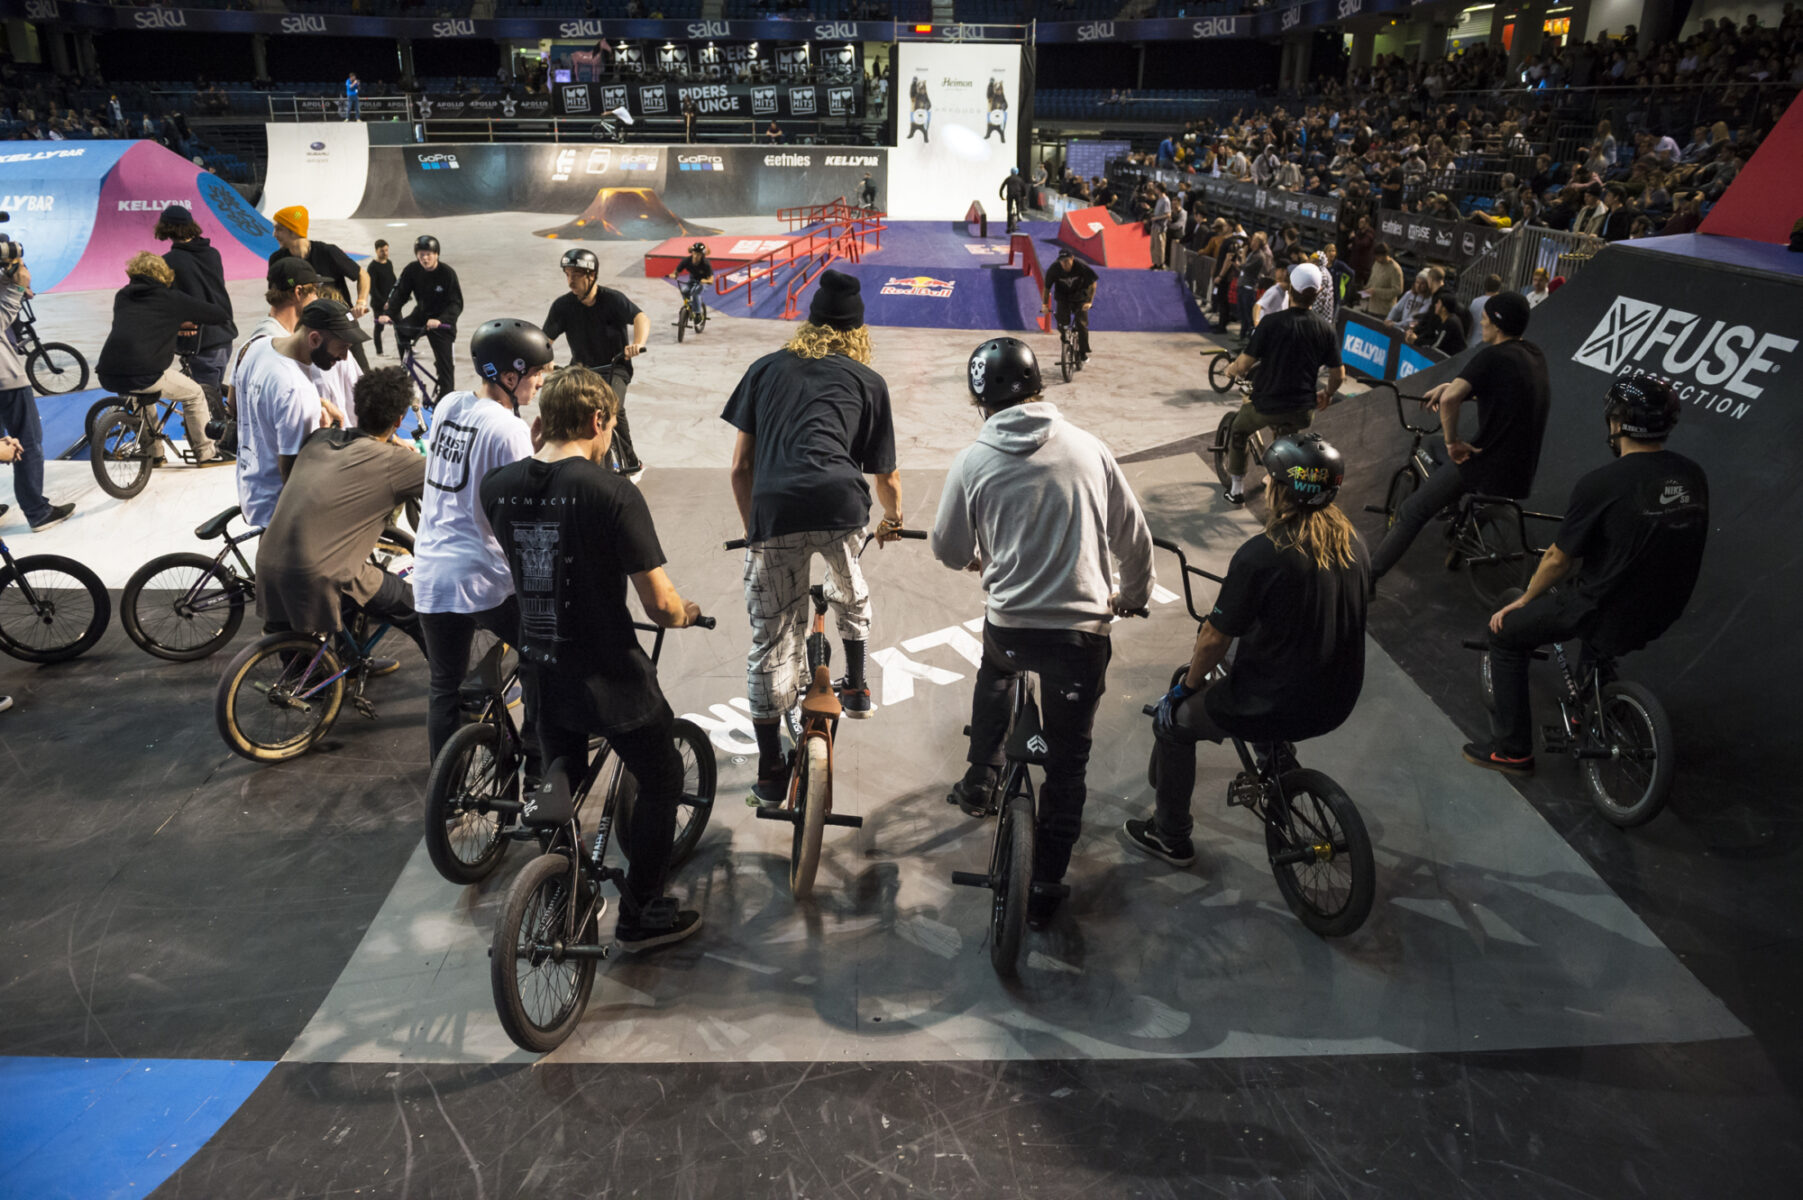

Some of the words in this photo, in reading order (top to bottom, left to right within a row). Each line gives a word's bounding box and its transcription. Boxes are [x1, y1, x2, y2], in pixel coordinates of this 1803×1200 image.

[25, 0, 60, 19] saku
[134, 8, 187, 29] saku
[281, 13, 327, 34] saku
[432, 19, 476, 38] saku
[560, 19, 603, 38] saku
[687, 20, 731, 40] saku
[815, 21, 858, 40] saku
[1077, 21, 1115, 42] saku
[1193, 17, 1236, 39] saku
[697, 45, 759, 64] RIDERS
[567, 97, 586, 106] HITS
[604, 97, 625, 106] HITS
[643, 97, 664, 106] HITS
[678, 84, 728, 101] RIDERS
[755, 98, 774, 107] HITS
[793, 98, 812, 108] HITS
[417, 153, 457, 162] GoPro
[677, 154, 722, 163] GoPro
[880, 286, 916, 295] Red
[915, 287, 953, 298] Bull
[1633, 308, 1800, 400] FUSE
[1617, 364, 1751, 420] PRECTION
[1664, 485, 1684, 495] NIKE
